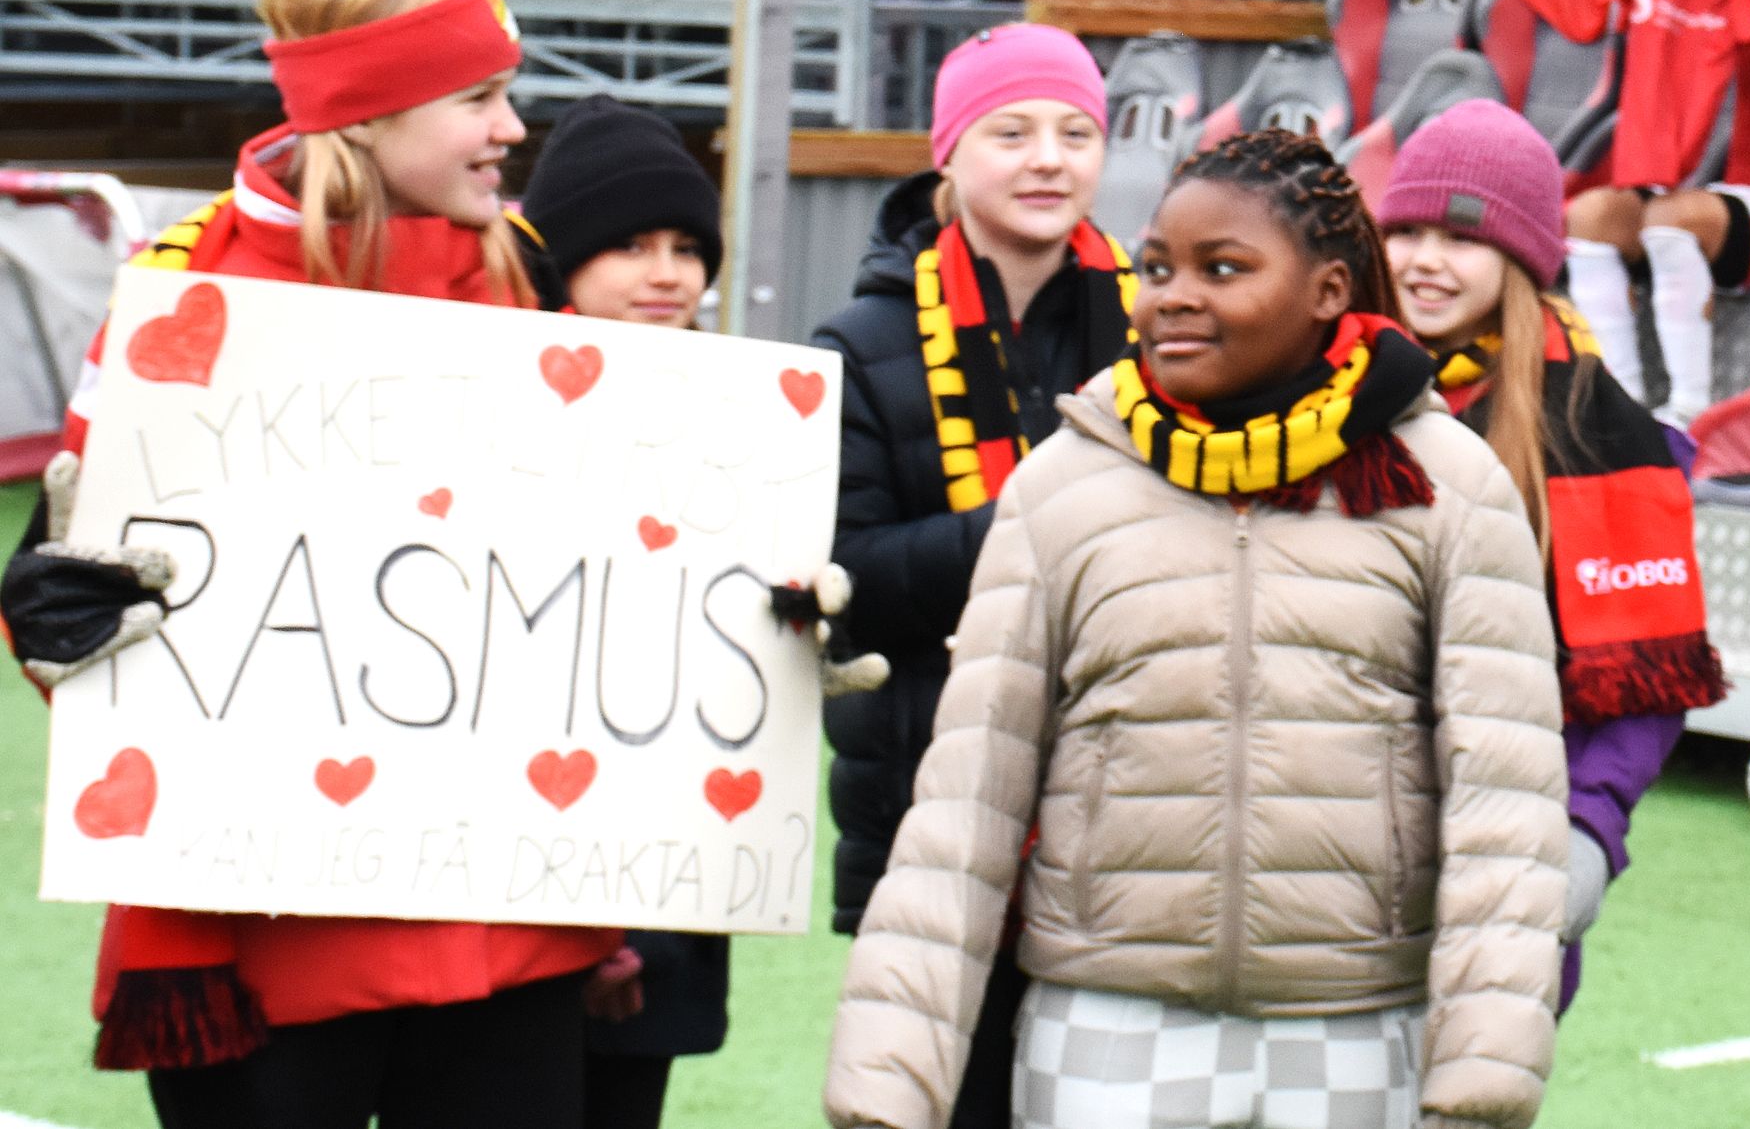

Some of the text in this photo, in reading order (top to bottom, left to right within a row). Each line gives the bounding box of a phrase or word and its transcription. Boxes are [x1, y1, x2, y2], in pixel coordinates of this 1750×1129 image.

[136, 374, 405, 505] LYKKE
[111, 515, 773, 751] RASMUS
[1611, 557, 1689, 590] OBOS
[303, 826, 386, 888] JEG
[408, 820, 473, 898] FÅ
[506, 834, 703, 912] DRAKTA
[726, 812, 811, 927] DI?
